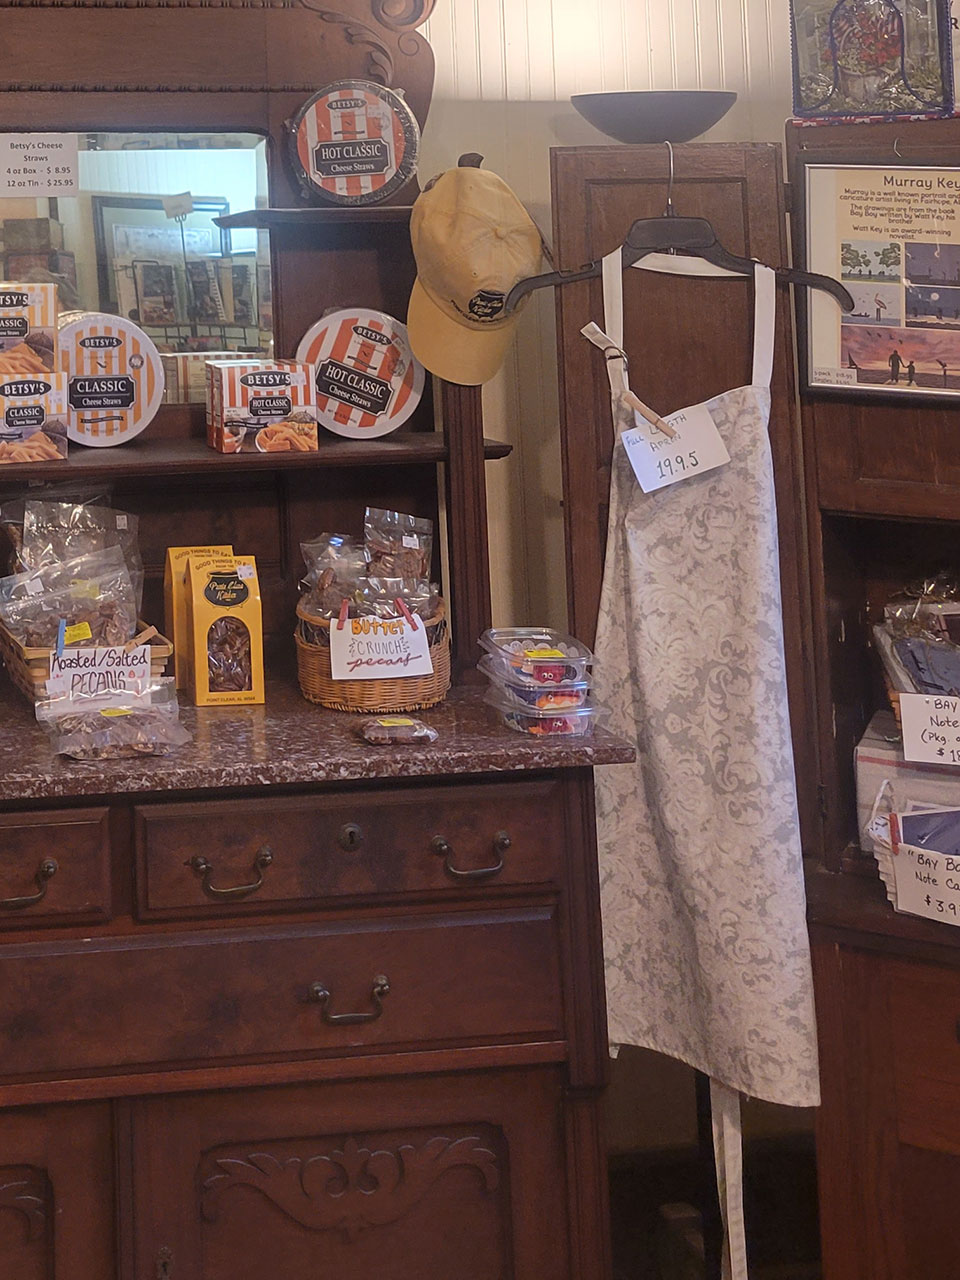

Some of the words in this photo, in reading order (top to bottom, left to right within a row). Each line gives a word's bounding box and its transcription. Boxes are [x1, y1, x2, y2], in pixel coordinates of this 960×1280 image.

[10, 142, 36, 150] Betsy's
[322, 147, 342, 160] HOT
[344, 144, 381, 158] CLASSIC
[331, 164, 352, 172] Cheese
[884, 176, 932, 190] Murray
[937, 178, 960, 191] Key
[357, 327, 388, 344] BETSY'S
[84, 338, 117, 346] BETSY'S
[248, 374, 290, 384] BETSY'S
[326, 365, 348, 382] HOT
[348, 374, 386, 398] CLASSIC
[4, 383, 45, 394] BETSY'S
[76, 380, 126, 392] CLASSIC
[82, 398, 102, 406] Cheese
[329, 384, 350, 400] Cheese
[351, 393, 372, 408] Straws
[266, 399, 288, 407] CLASSIC
[10, 408, 40, 417] CLASSIC
[649, 414, 687, 434] LGTH
[196, 561, 211, 570] GOOD
[357, 640, 400, 656] CRUNCH
[930, 715, 960, 728] Note
[915, 871, 938, 886] Note
